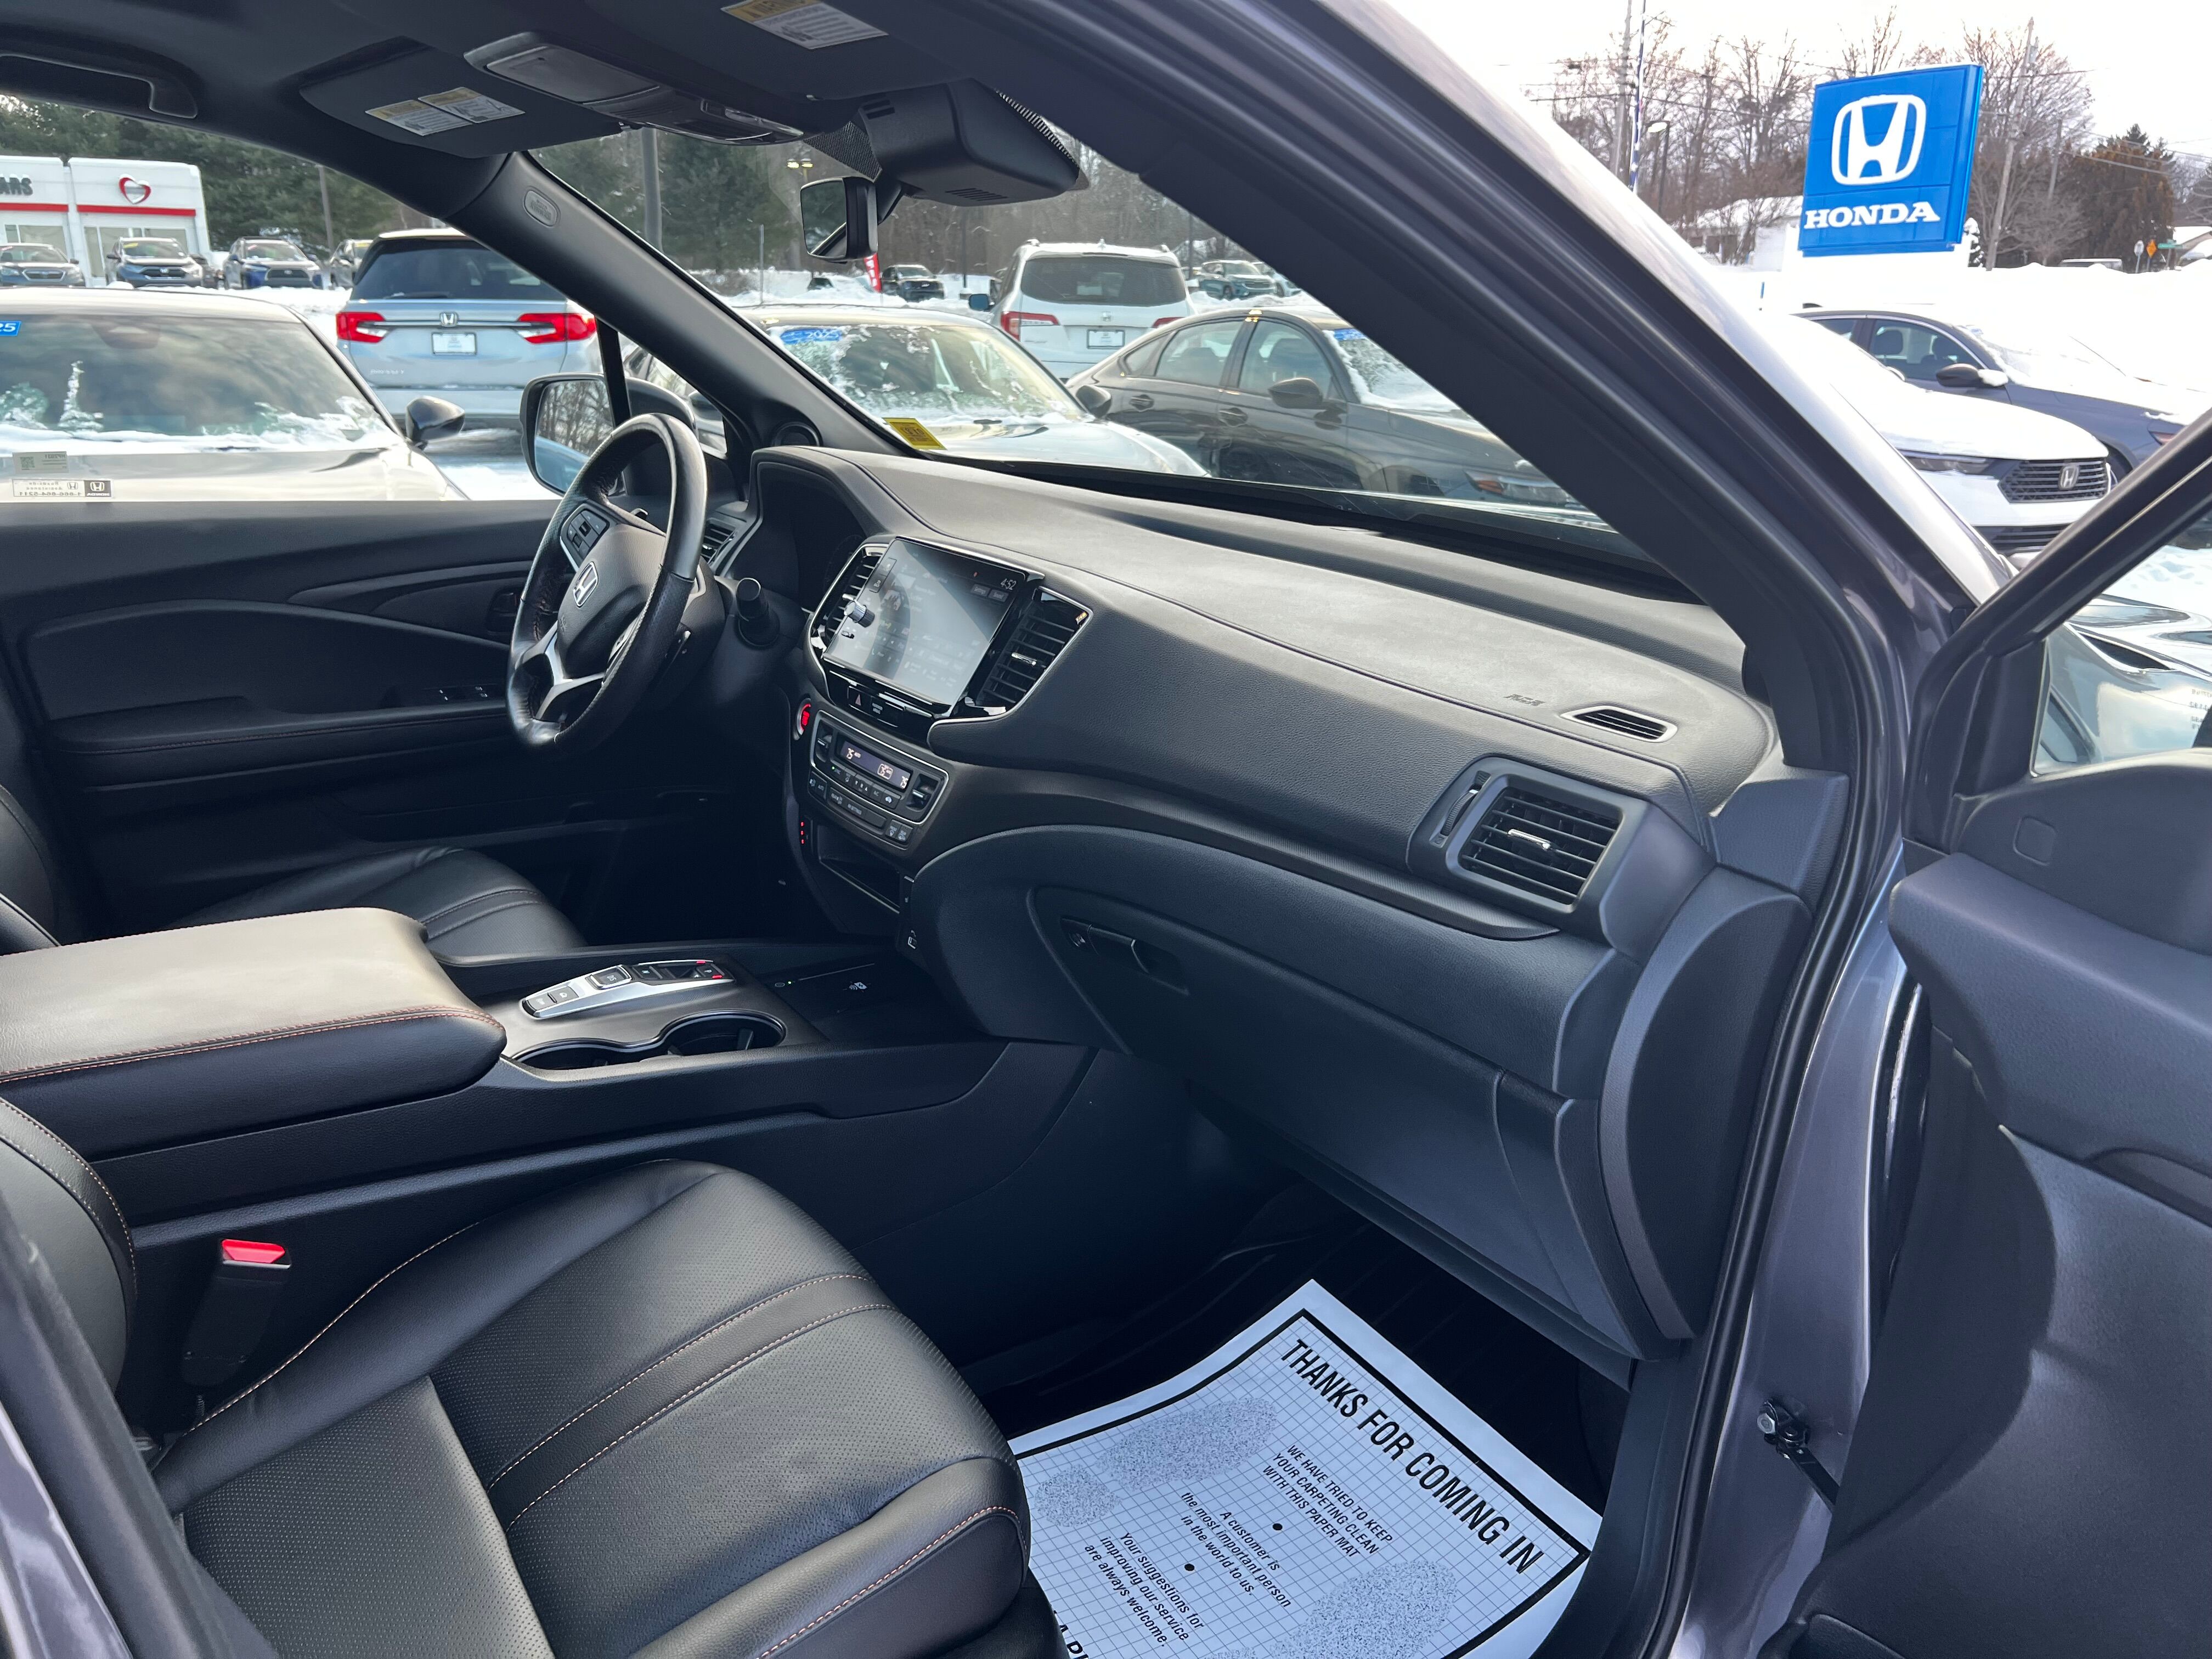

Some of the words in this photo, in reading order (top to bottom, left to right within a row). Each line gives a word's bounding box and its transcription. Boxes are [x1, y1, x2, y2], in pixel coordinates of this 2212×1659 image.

[1804, 201, 1940, 229] HONDA
[1000, 578, 1017, 590] 4:52
[1273, 1453, 1300, 1478] YOUR
[1296, 1477, 1348, 1525] CARPETING
[1345, 1523, 1379, 1554] CLEAN
[1281, 1339, 1368, 1417] THANKS
[1357, 1409, 1414, 1461] FOR
[1405, 1452, 1510, 1545] COMING
[1499, 1535, 1545, 1574] IN
[1287, 1444, 1306, 1462] WE
[1301, 1459, 1329, 1483] HAVE
[1324, 1480, 1355, 1507] TRIED
[1352, 1505, 1368, 1520] TO
[1364, 1519, 1393, 1542] KEEP
[1181, 1492, 1198, 1507] the
[1195, 1508, 1221, 1530] most
[1216, 1530, 1262, 1574] important
[1254, 1574, 1291, 1607] person
[1181, 1515, 1194, 1526] in
[1190, 1525, 1207, 1541] the
[1205, 1542, 1234, 1568] world
[1229, 1567, 1242, 1579] to
[1239, 1579, 1254, 1595] us.
[1220, 1512, 1232, 1520] A
[1228, 1520, 1271, 1560] customer
[1267, 1560, 1280, 1571] is
[1262, 1465, 1290, 1489] WITH
[1285, 1487, 1309, 1509] THIS
[1305, 1508, 1339, 1538] PAPER
[1334, 1536, 1361, 1557] MAT
[1085, 1545, 1102, 1561] are
[1098, 1562, 1130, 1596] always
[1126, 1596, 1168, 1647] welcome.
[1100, 1536, 1144, 1585] improving
[1139, 1585, 1159, 1602] our
[1154, 1603, 1189, 1641] service
[1120, 1532, 1142, 1555] Your
[1138, 1556, 1190, 1613] suggestions
[1186, 1613, 1204, 1629] for
